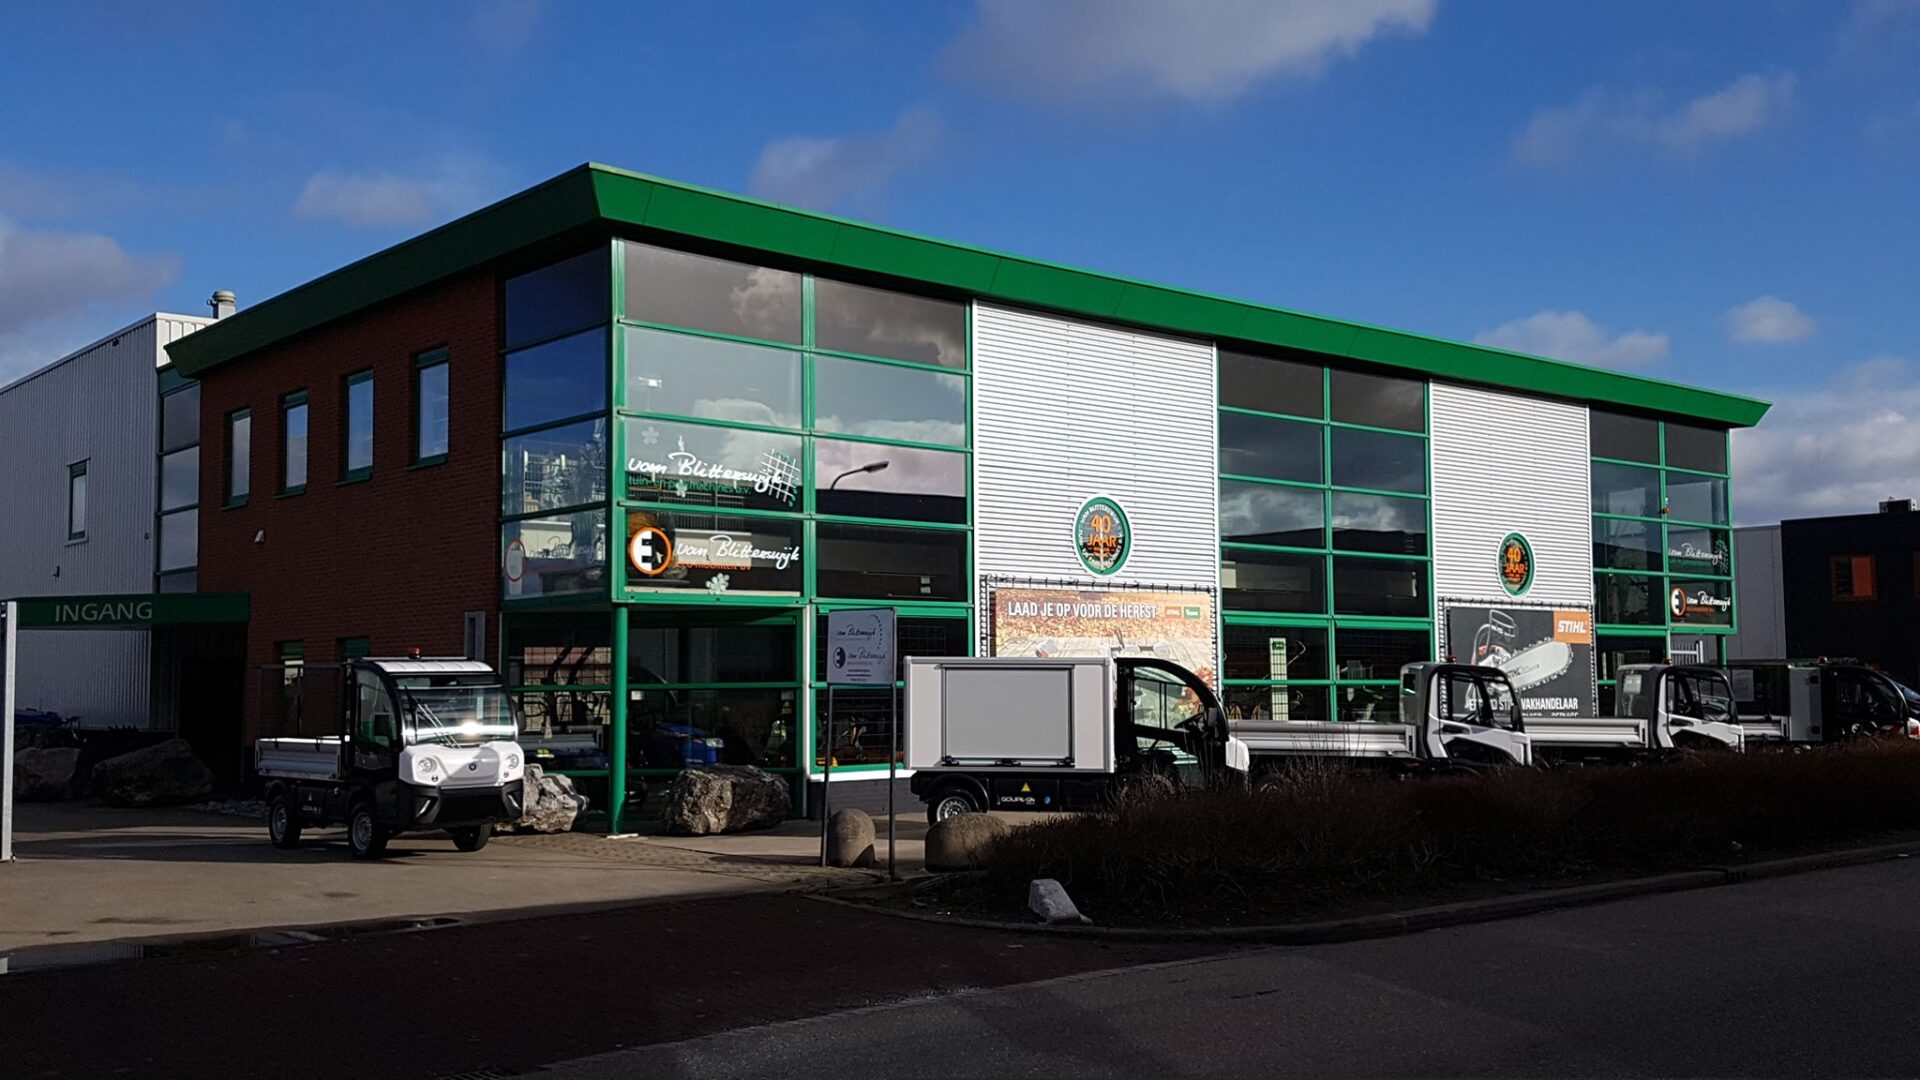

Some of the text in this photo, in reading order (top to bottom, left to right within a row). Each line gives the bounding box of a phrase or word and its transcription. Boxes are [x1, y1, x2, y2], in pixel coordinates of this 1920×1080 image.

[628, 458, 667, 475] van
[1091, 514, 1112, 533] 40
[1087, 534, 1118, 548] JAAR
[677, 543, 708, 557] van
[1507, 547, 1521, 562] 40
[1505, 562, 1525, 573] JAAR
[55, 602, 153, 622] INGANG
[1008, 602, 1158, 619] LAAD JE OP VOOR DE HERFST
[1557, 620, 1587, 634] STIHL
[1521, 697, 1578, 711] VAKHANDELAAR
